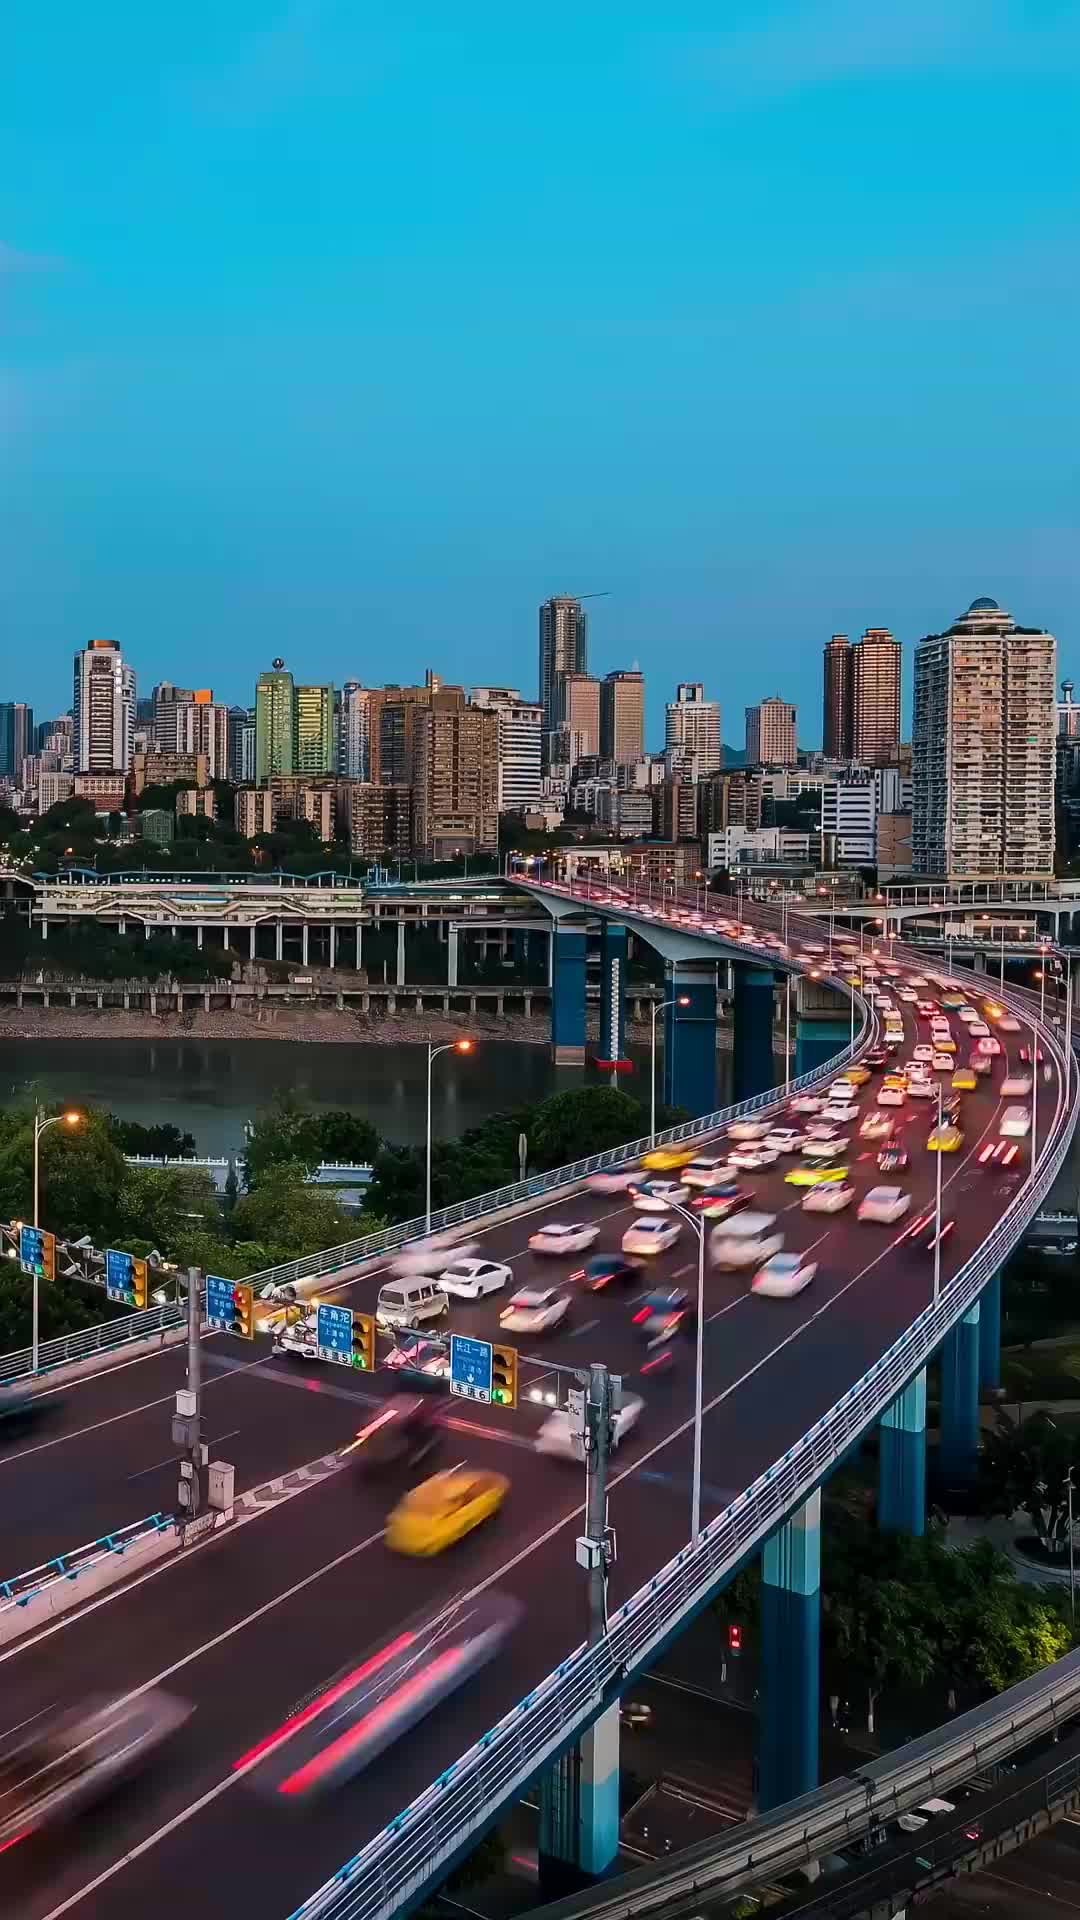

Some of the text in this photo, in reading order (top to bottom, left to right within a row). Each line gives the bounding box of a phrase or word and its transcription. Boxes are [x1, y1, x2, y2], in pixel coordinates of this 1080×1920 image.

[320, 1307, 349, 1323] 牛角沱
[456, 1339, 488, 1358] 长江一路
